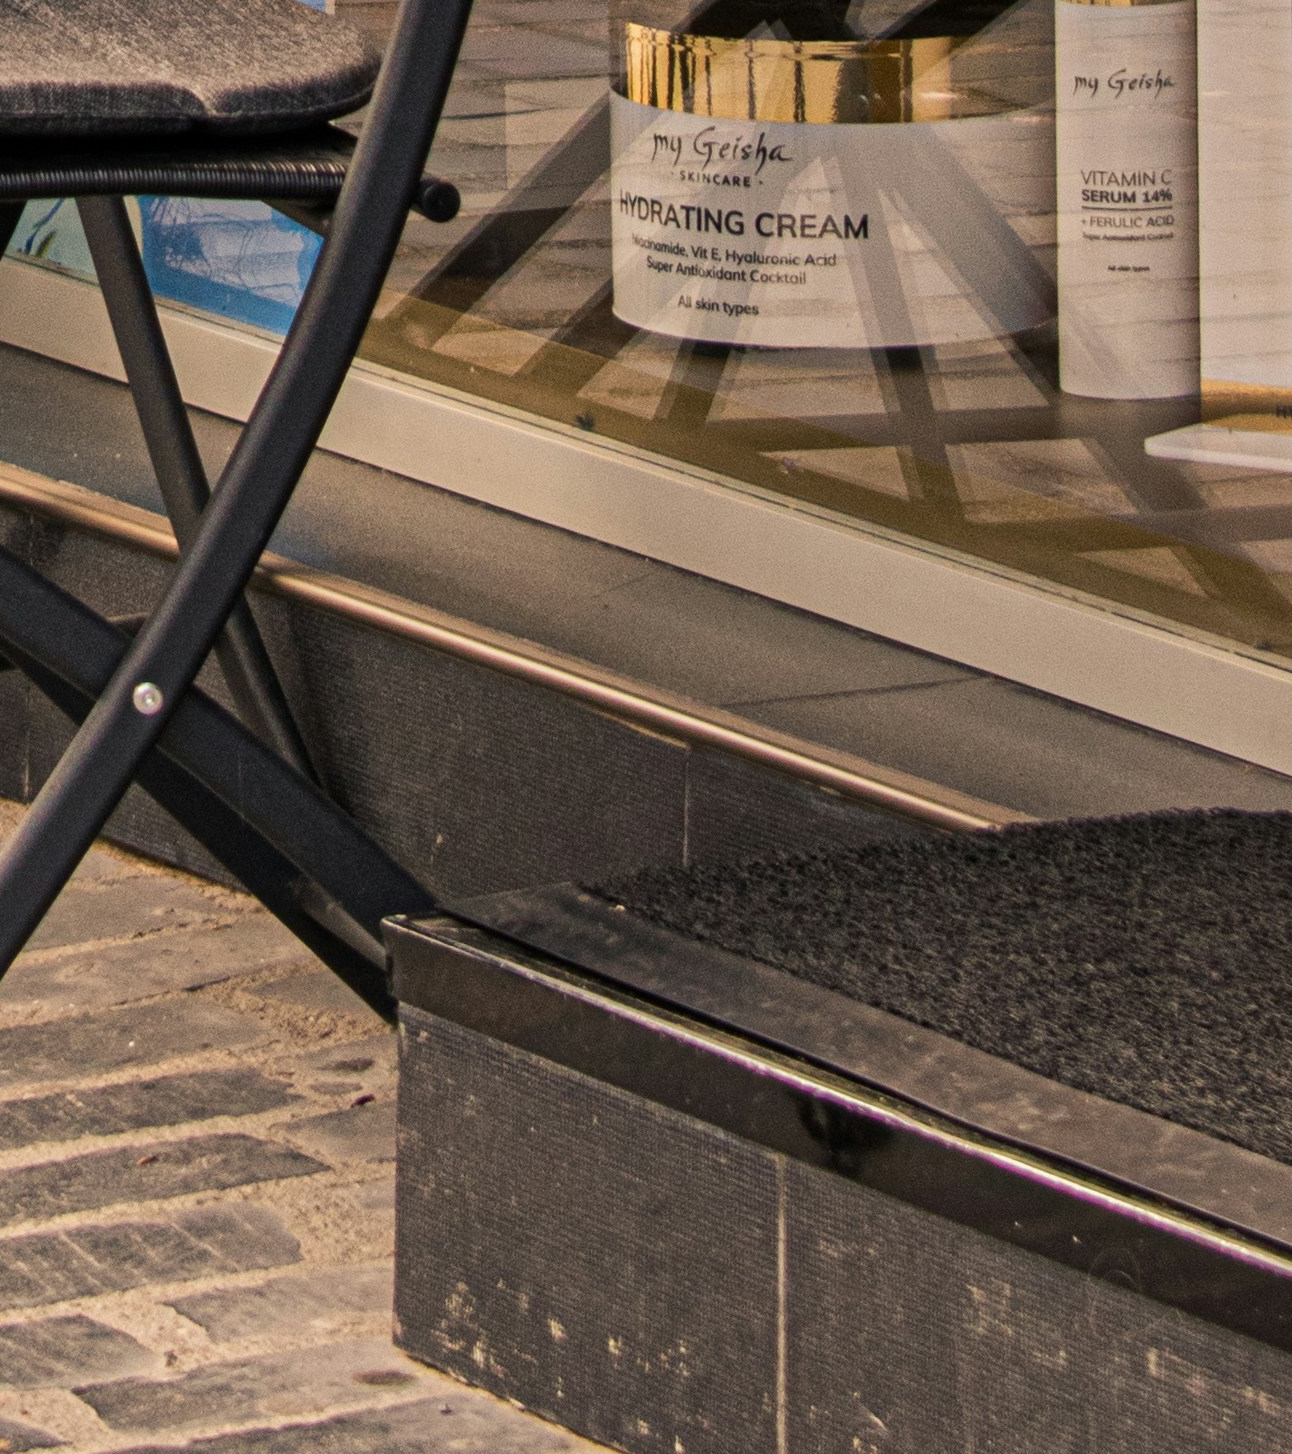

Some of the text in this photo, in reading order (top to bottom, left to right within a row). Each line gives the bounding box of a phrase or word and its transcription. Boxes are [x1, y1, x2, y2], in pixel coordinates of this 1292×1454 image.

[1074, 68, 1176, 100] my Geisha
[651, 126, 793, 176] my Geisha
[679, 169, 752, 188] SKINCARE
[1080, 169, 1173, 187] VITAMIN C
[1082, 189, 1173, 203] SERUM 14%
[620, 189, 870, 240] HYDRATING CREAM
[1089, 216, 1142, 229] FERULIC
[1146, 214, 1175, 228] ACID
[691, 244, 708, 260] Vit
[725, 249, 800, 267] Hyaluronic
[804, 253, 837, 267] Acid
[646, 255, 807, 285] Super Antioxidant Cocktail
[677, 294, 760, 318] All skin types
